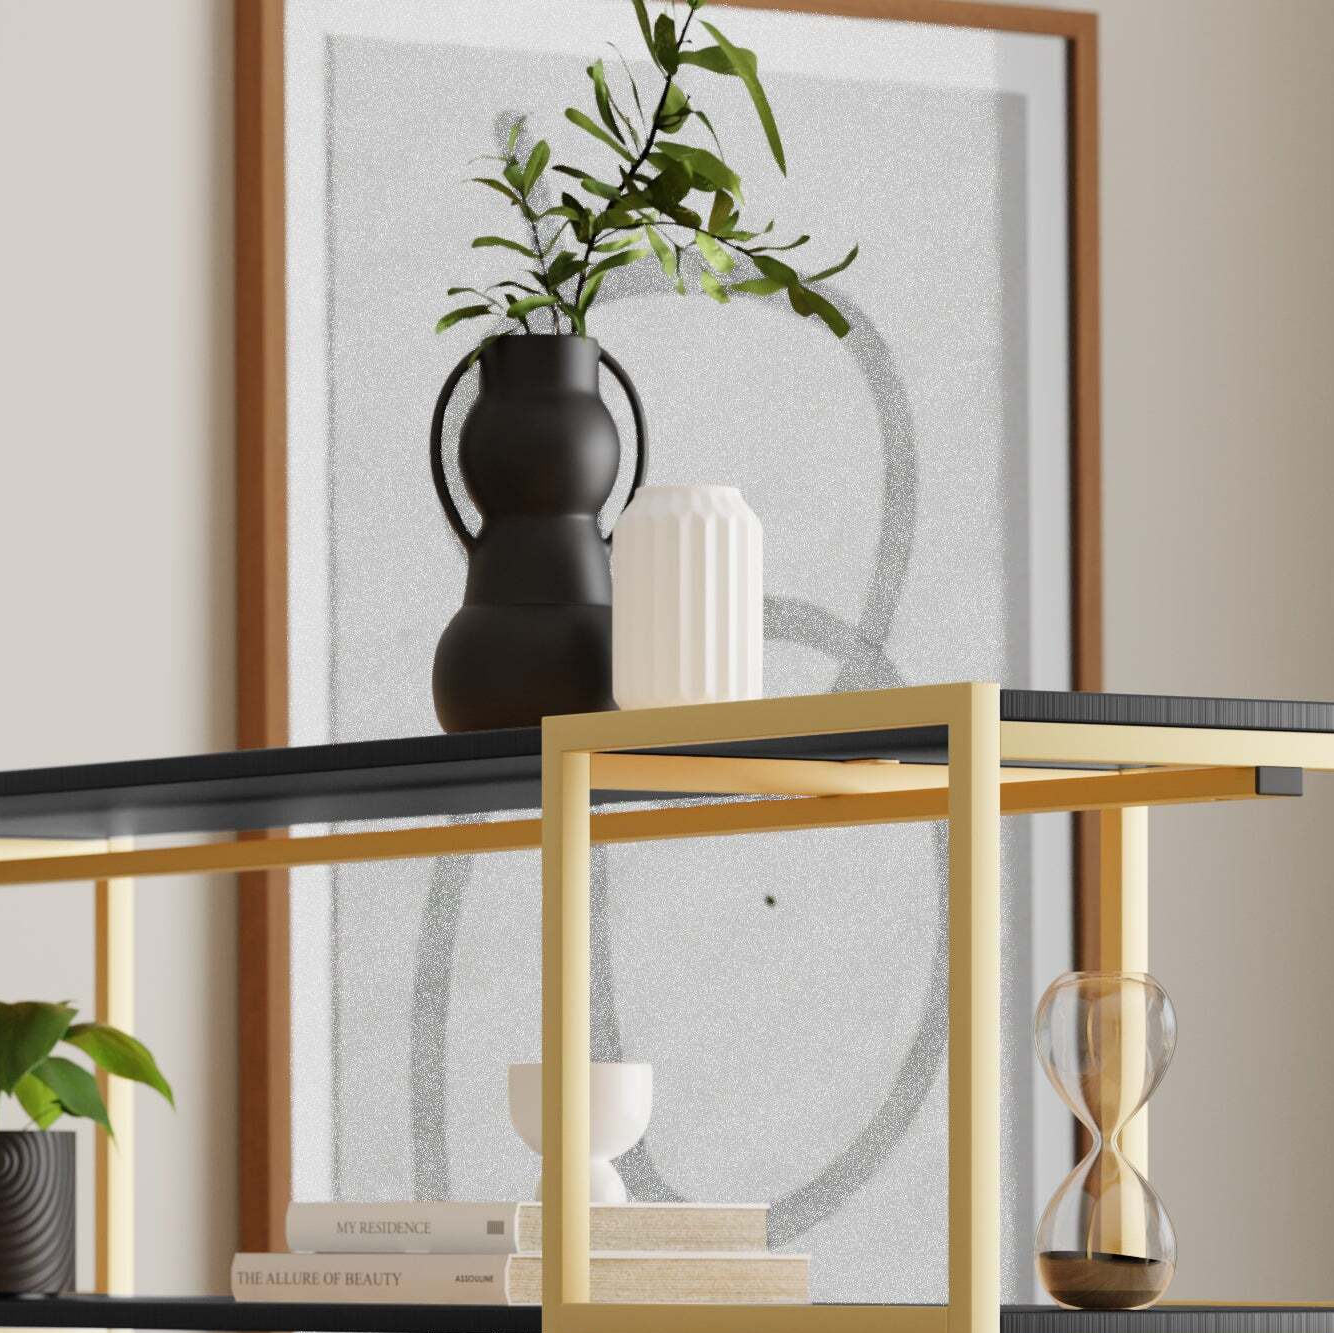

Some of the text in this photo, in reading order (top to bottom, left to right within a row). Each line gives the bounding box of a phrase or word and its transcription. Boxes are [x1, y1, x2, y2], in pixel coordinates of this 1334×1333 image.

[336, 1221, 432, 1234] MY RESIDENCE
[236, 1271, 403, 1286] THE ALLURE OF BEAUTY
